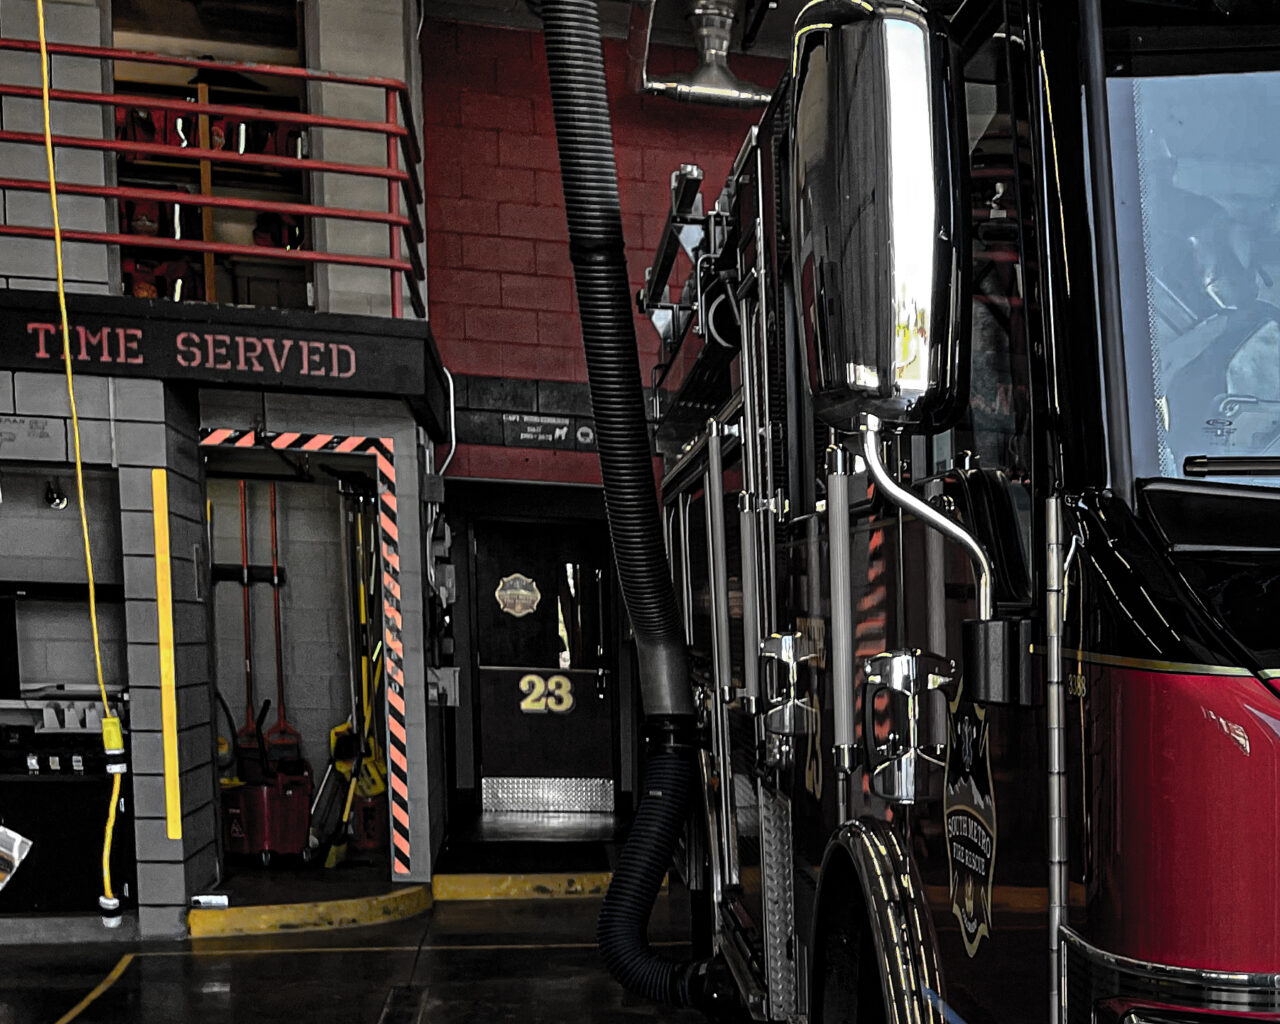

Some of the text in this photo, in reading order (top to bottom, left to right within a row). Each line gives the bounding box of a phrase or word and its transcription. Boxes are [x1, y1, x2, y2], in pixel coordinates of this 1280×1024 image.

[176, 332, 356, 378] SERVED
[519, 674, 574, 714] 23
[948, 815, 991, 858] SOUTH METRO
[953, 842, 964, 864] FIRE
